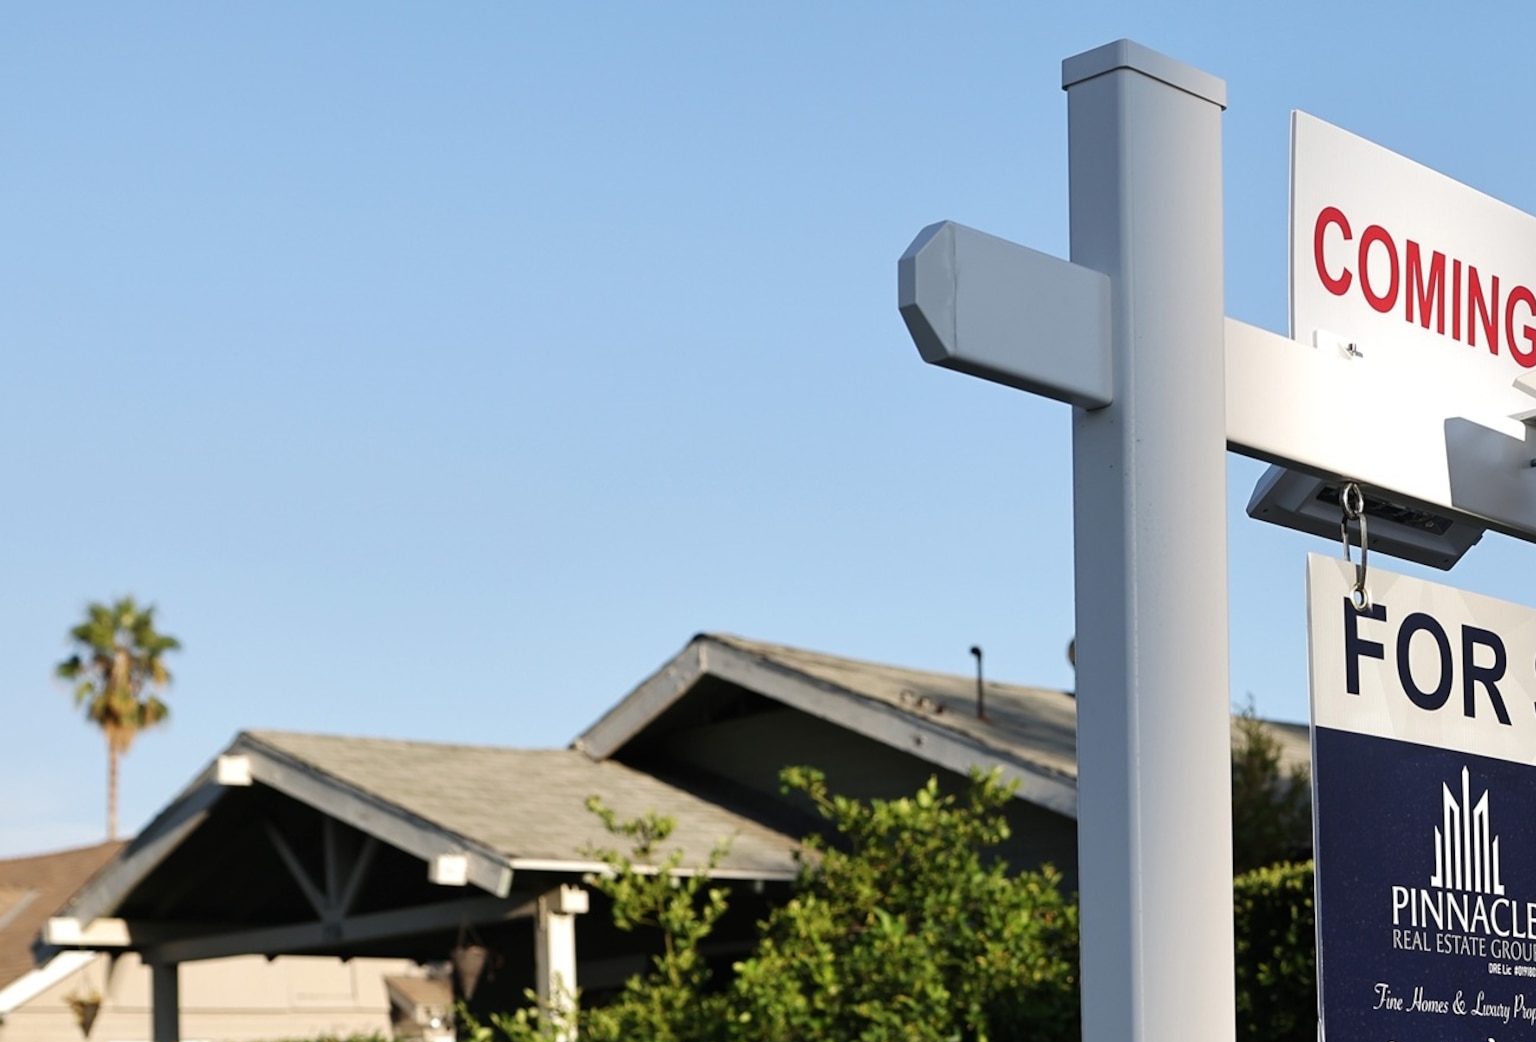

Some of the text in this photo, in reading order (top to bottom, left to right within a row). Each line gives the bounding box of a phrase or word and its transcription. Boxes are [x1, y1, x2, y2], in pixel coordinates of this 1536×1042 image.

[1343, 596, 1512, 726] FOR
[1392, 928, 1431, 952] REAL
[1436, 933, 1487, 957] ESTATE
[1488, 962, 1501, 974] DRE
[1502, 964, 1512, 975] Lic
[1373, 983, 1403, 1012] Fine
[1406, 986, 1449, 1014] Homes
[1452, 990, 1467, 1015] &
[1471, 991, 1510, 1024] Luxury
